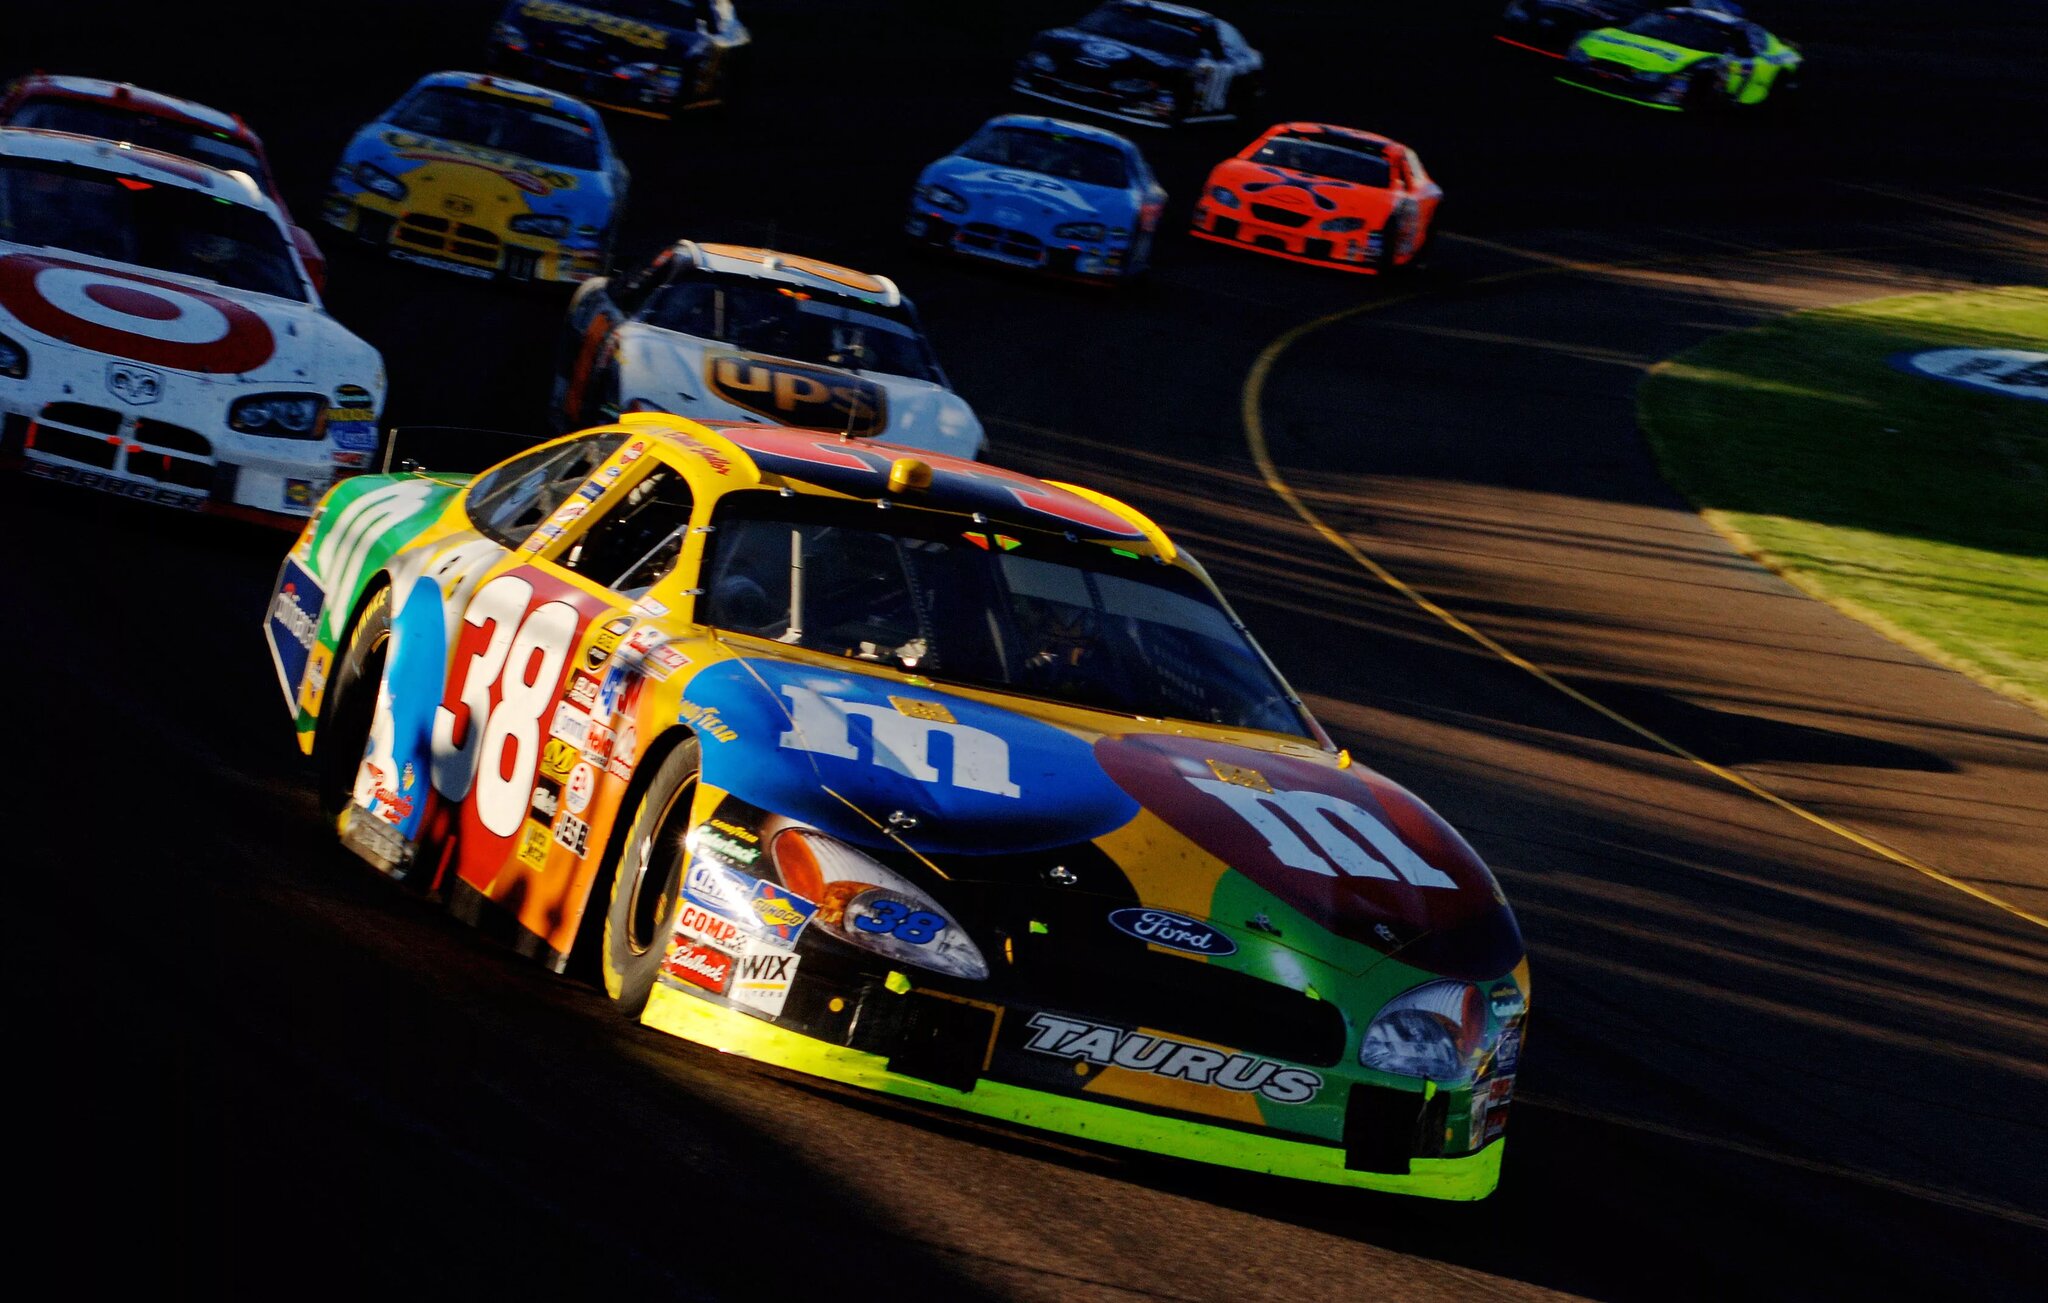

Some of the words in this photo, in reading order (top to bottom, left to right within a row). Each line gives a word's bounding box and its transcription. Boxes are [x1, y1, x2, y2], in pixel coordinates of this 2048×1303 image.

[716, 360, 877, 420] ups
[430, 575, 580, 838] 38
[780, 684, 1021, 798] m
[1183, 775, 1460, 890] m
[682, 907, 737, 943] COMP
[753, 899, 807, 927] SUNOCO
[854, 899, 948, 945] 38
[1133, 911, 1212, 950] Ford
[741, 954, 794, 982] WIX
[1024, 1011, 1324, 1105] TAURUS
